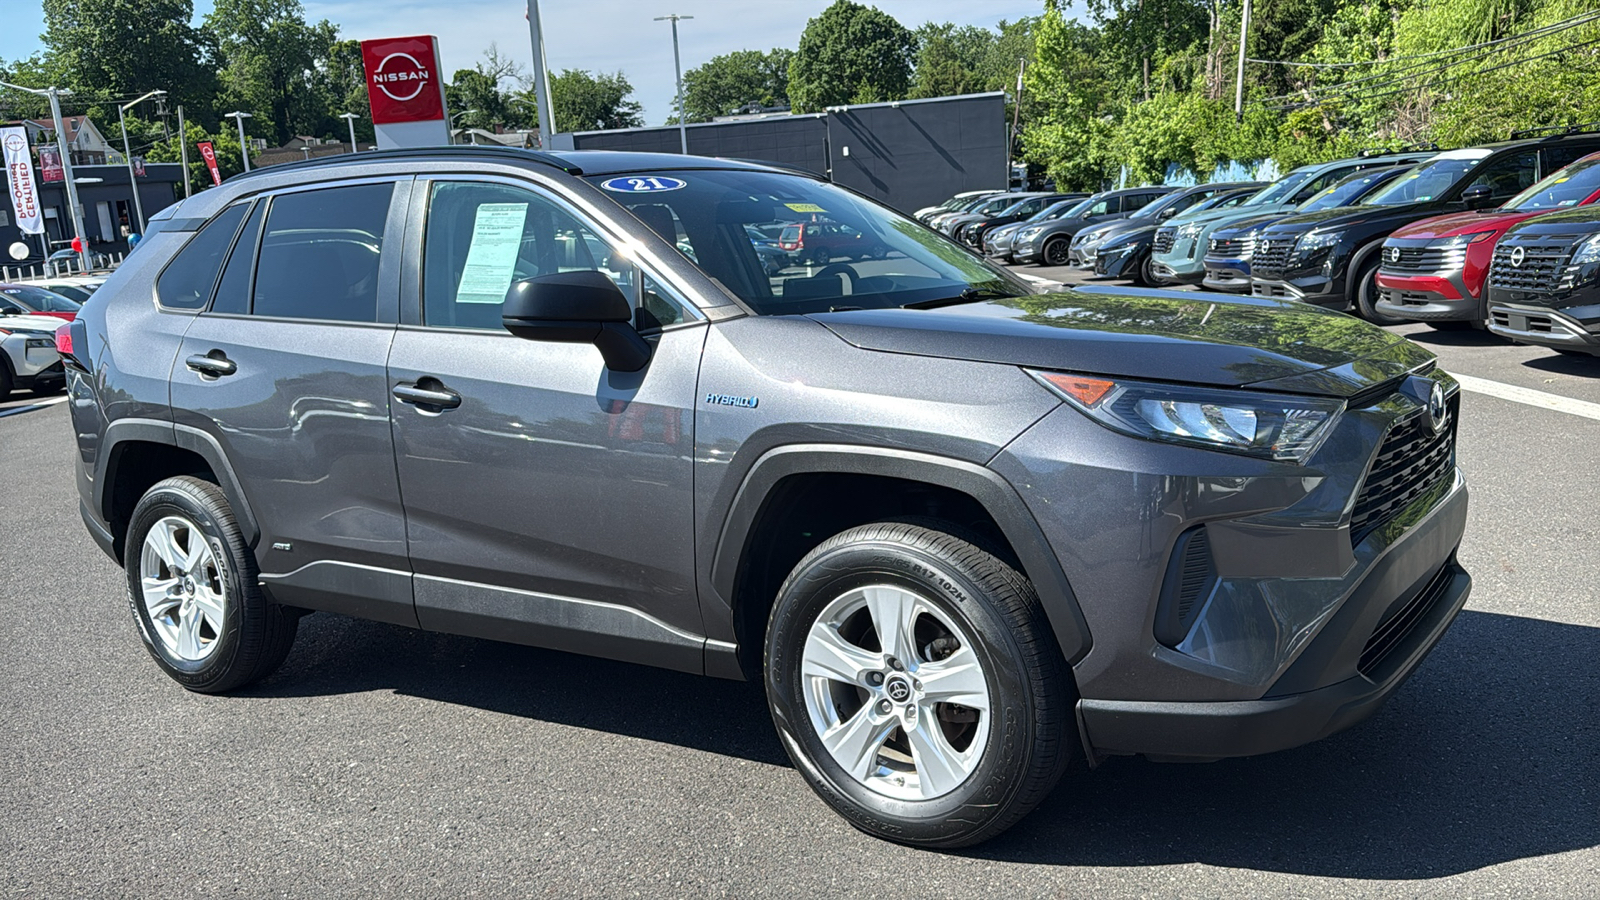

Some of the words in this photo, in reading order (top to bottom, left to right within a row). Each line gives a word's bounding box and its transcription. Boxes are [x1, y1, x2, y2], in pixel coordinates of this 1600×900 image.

[373, 71, 429, 83] NISSAN
[627, 177, 669, 191] 21
[706, 393, 749, 407] HYBRID
[872, 555, 912, 569] 225/65
[912, 563, 937, 579] R17
[938, 577, 967, 603] 102H
